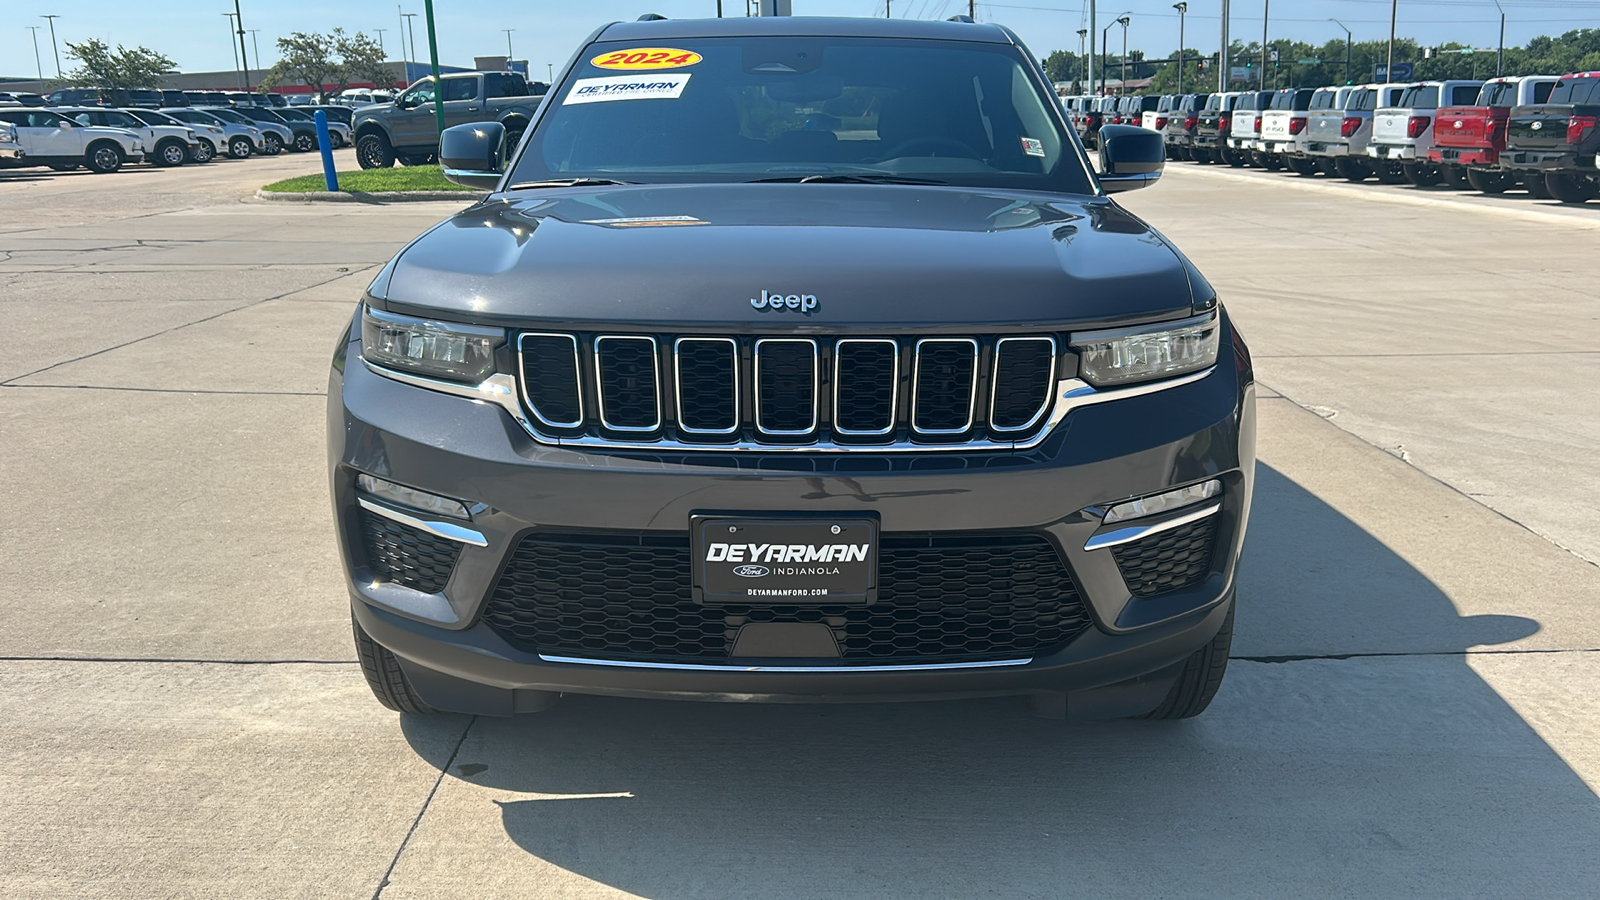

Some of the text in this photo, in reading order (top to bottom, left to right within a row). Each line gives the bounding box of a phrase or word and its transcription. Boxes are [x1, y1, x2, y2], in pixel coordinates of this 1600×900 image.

[600, 53, 691, 65] 2024
[576, 82, 680, 95] DEYARMAN
[750, 289, 818, 313] Jeep
[706, 543, 870, 563] DEYARMAN
[739, 565, 840, 576] Ford INDIANOLA
[747, 588, 828, 596] DEYARMANFORD.COM
